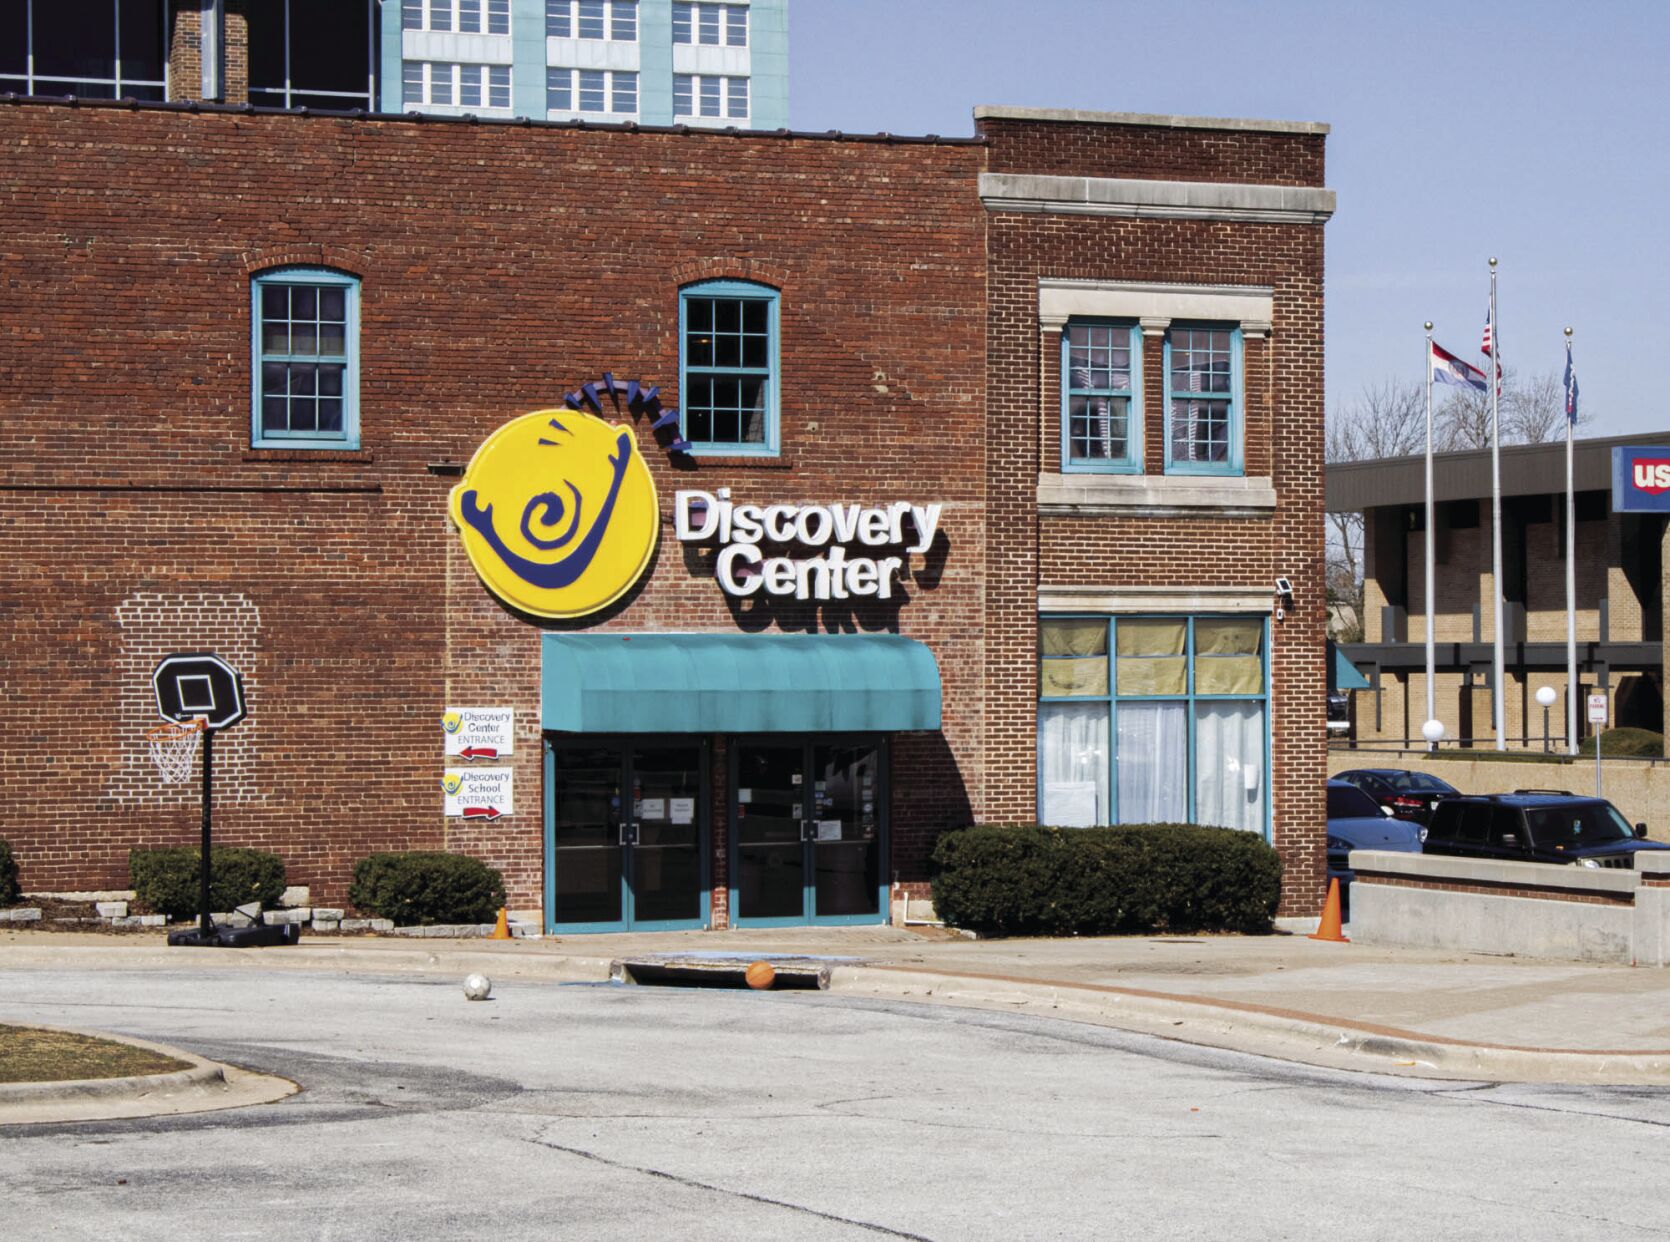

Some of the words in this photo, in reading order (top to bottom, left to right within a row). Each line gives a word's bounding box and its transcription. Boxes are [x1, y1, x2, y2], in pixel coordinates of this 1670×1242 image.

[675, 488, 942, 553] Discovery
[717, 543, 902, 599] Center
[464, 712, 510, 722] Discovery
[468, 723, 500, 733] Center
[458, 735, 505, 744] ENTRANCE
[463, 772, 509, 783] Discovery
[468, 784, 501, 793] School
[457, 795, 504, 804] ENTRANCE
